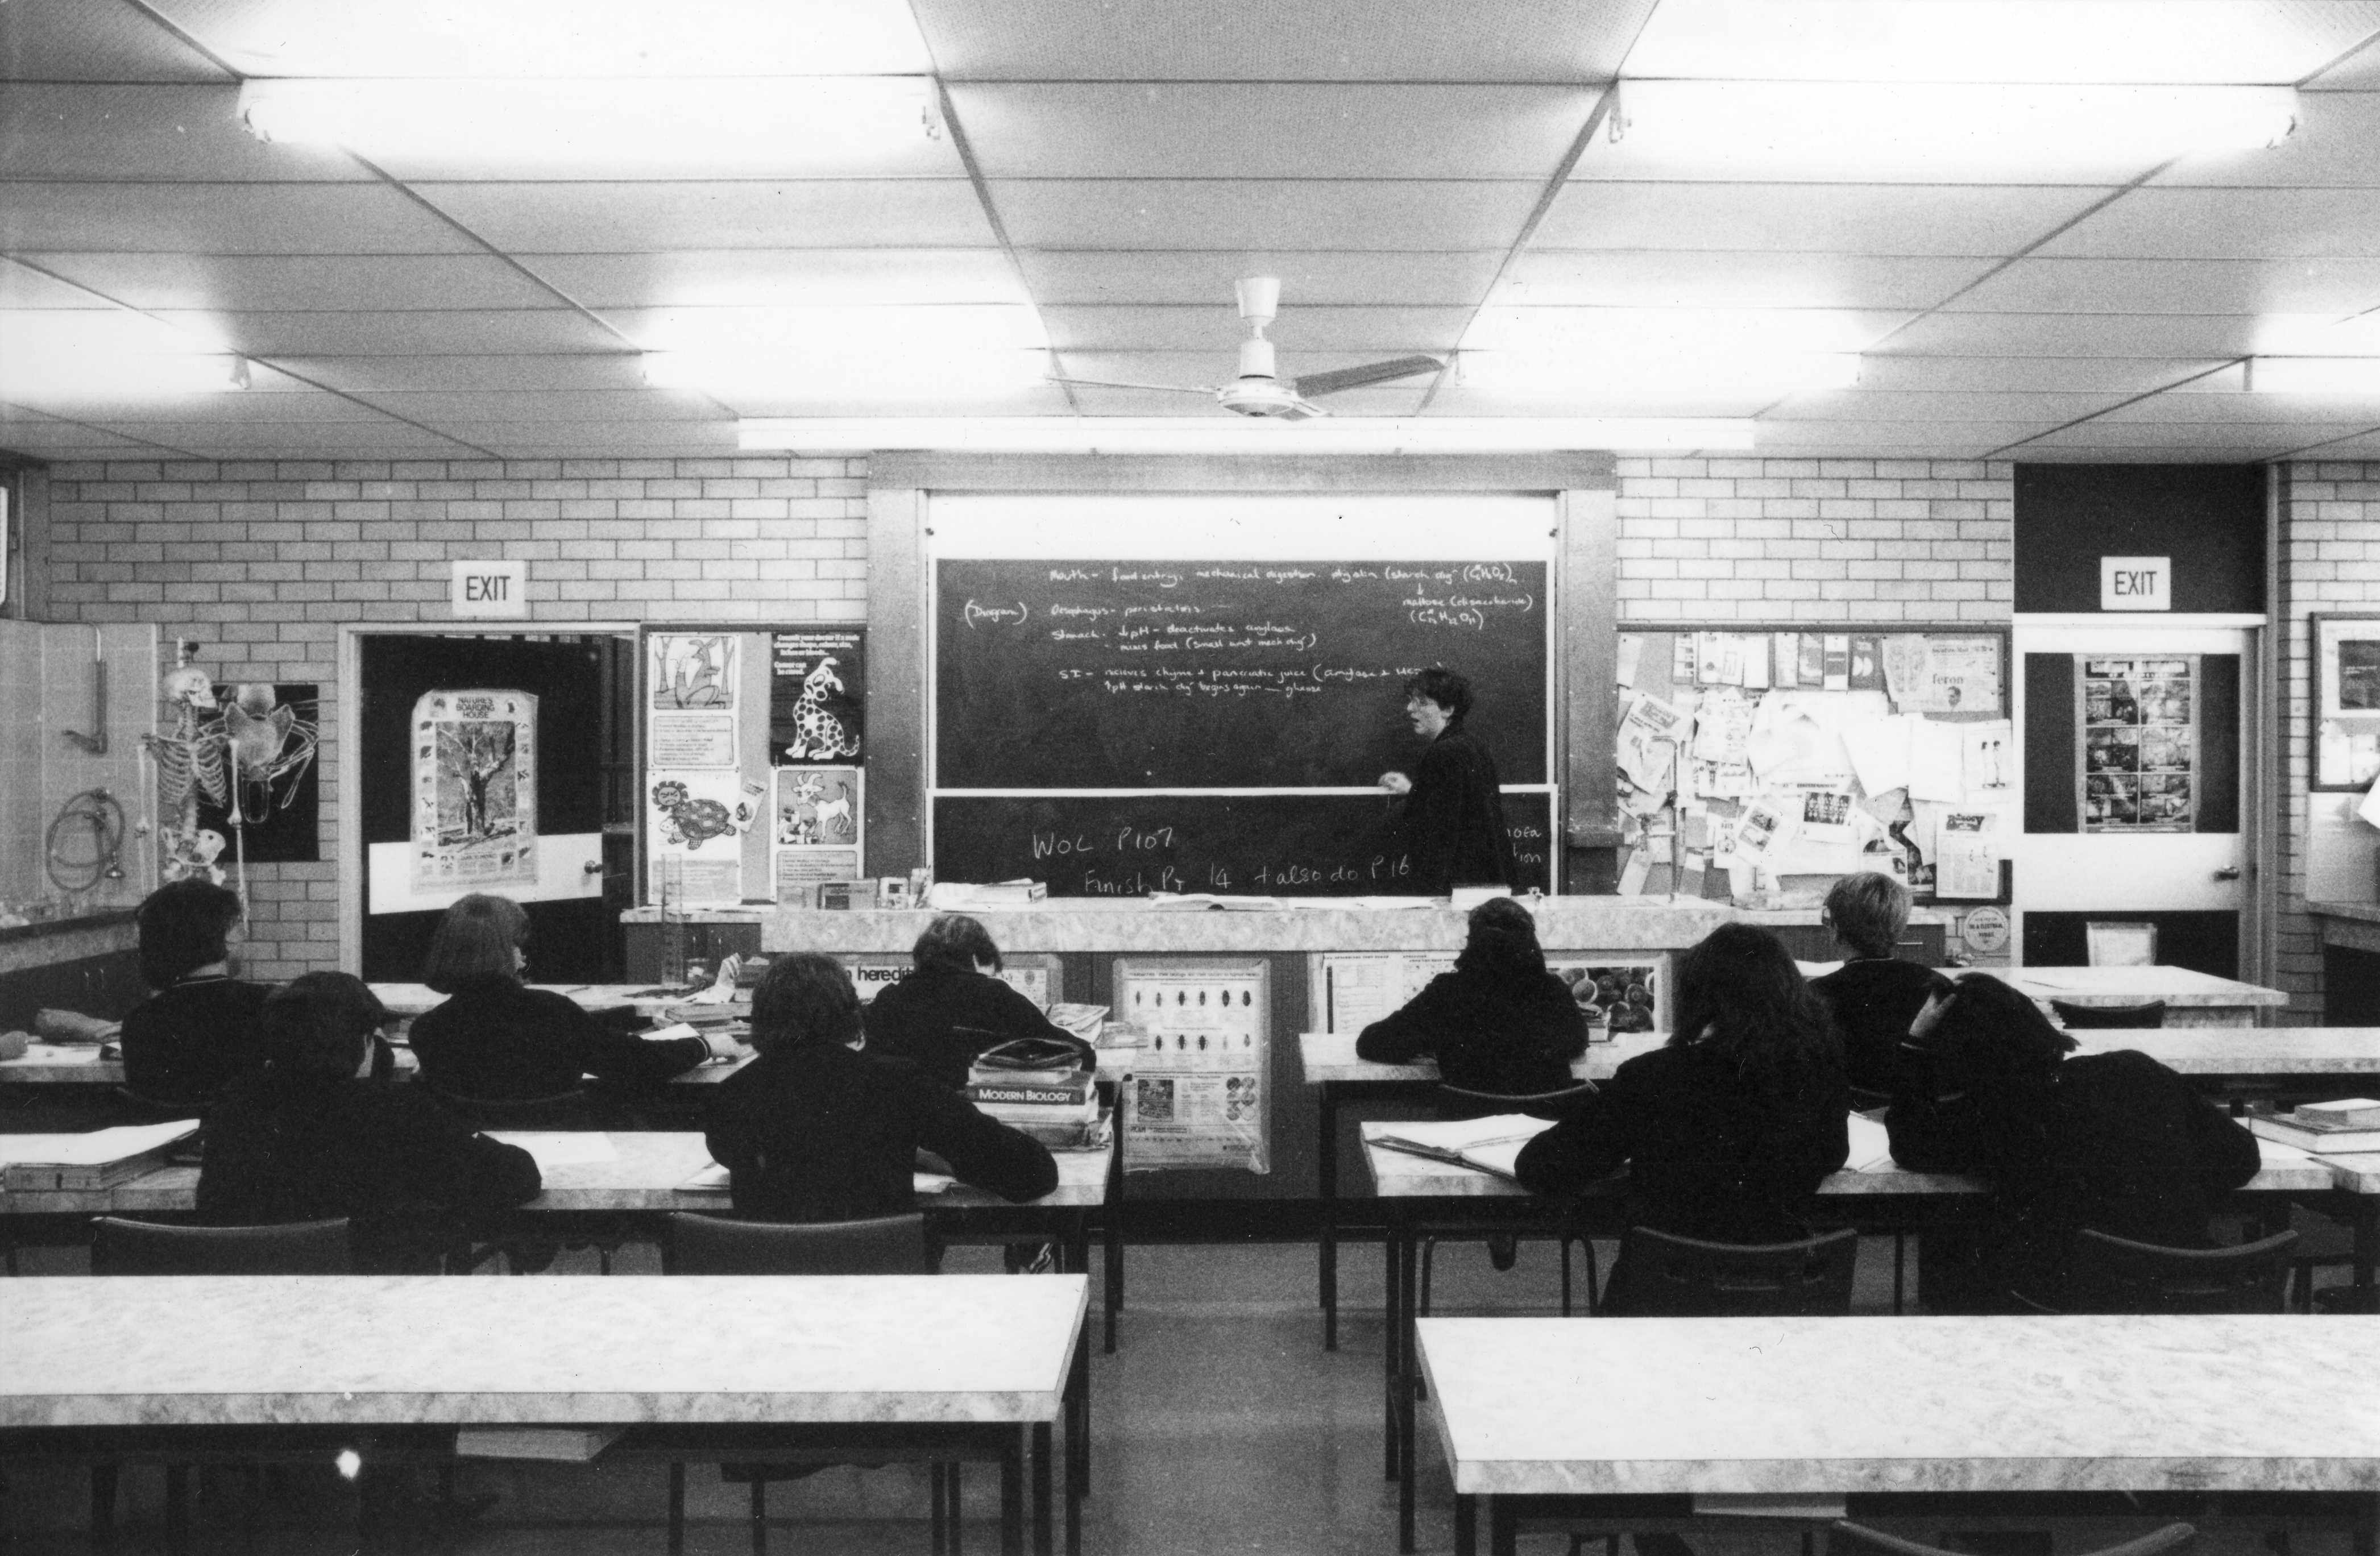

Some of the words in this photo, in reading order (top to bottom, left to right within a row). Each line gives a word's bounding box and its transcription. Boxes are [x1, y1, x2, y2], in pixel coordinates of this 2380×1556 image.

[466, 576, 511, 601] EXIT
[2114, 571, 2157, 595] EXIT
[1084, 869, 1154, 894] Finish
[1210, 862, 1233, 889] 14
[1276, 865, 1322, 885] also
[1330, 865, 1358, 882] do
[979, 1089, 1024, 1101] MODERN
[1026, 1090, 1071, 1102] BIOLOGY
